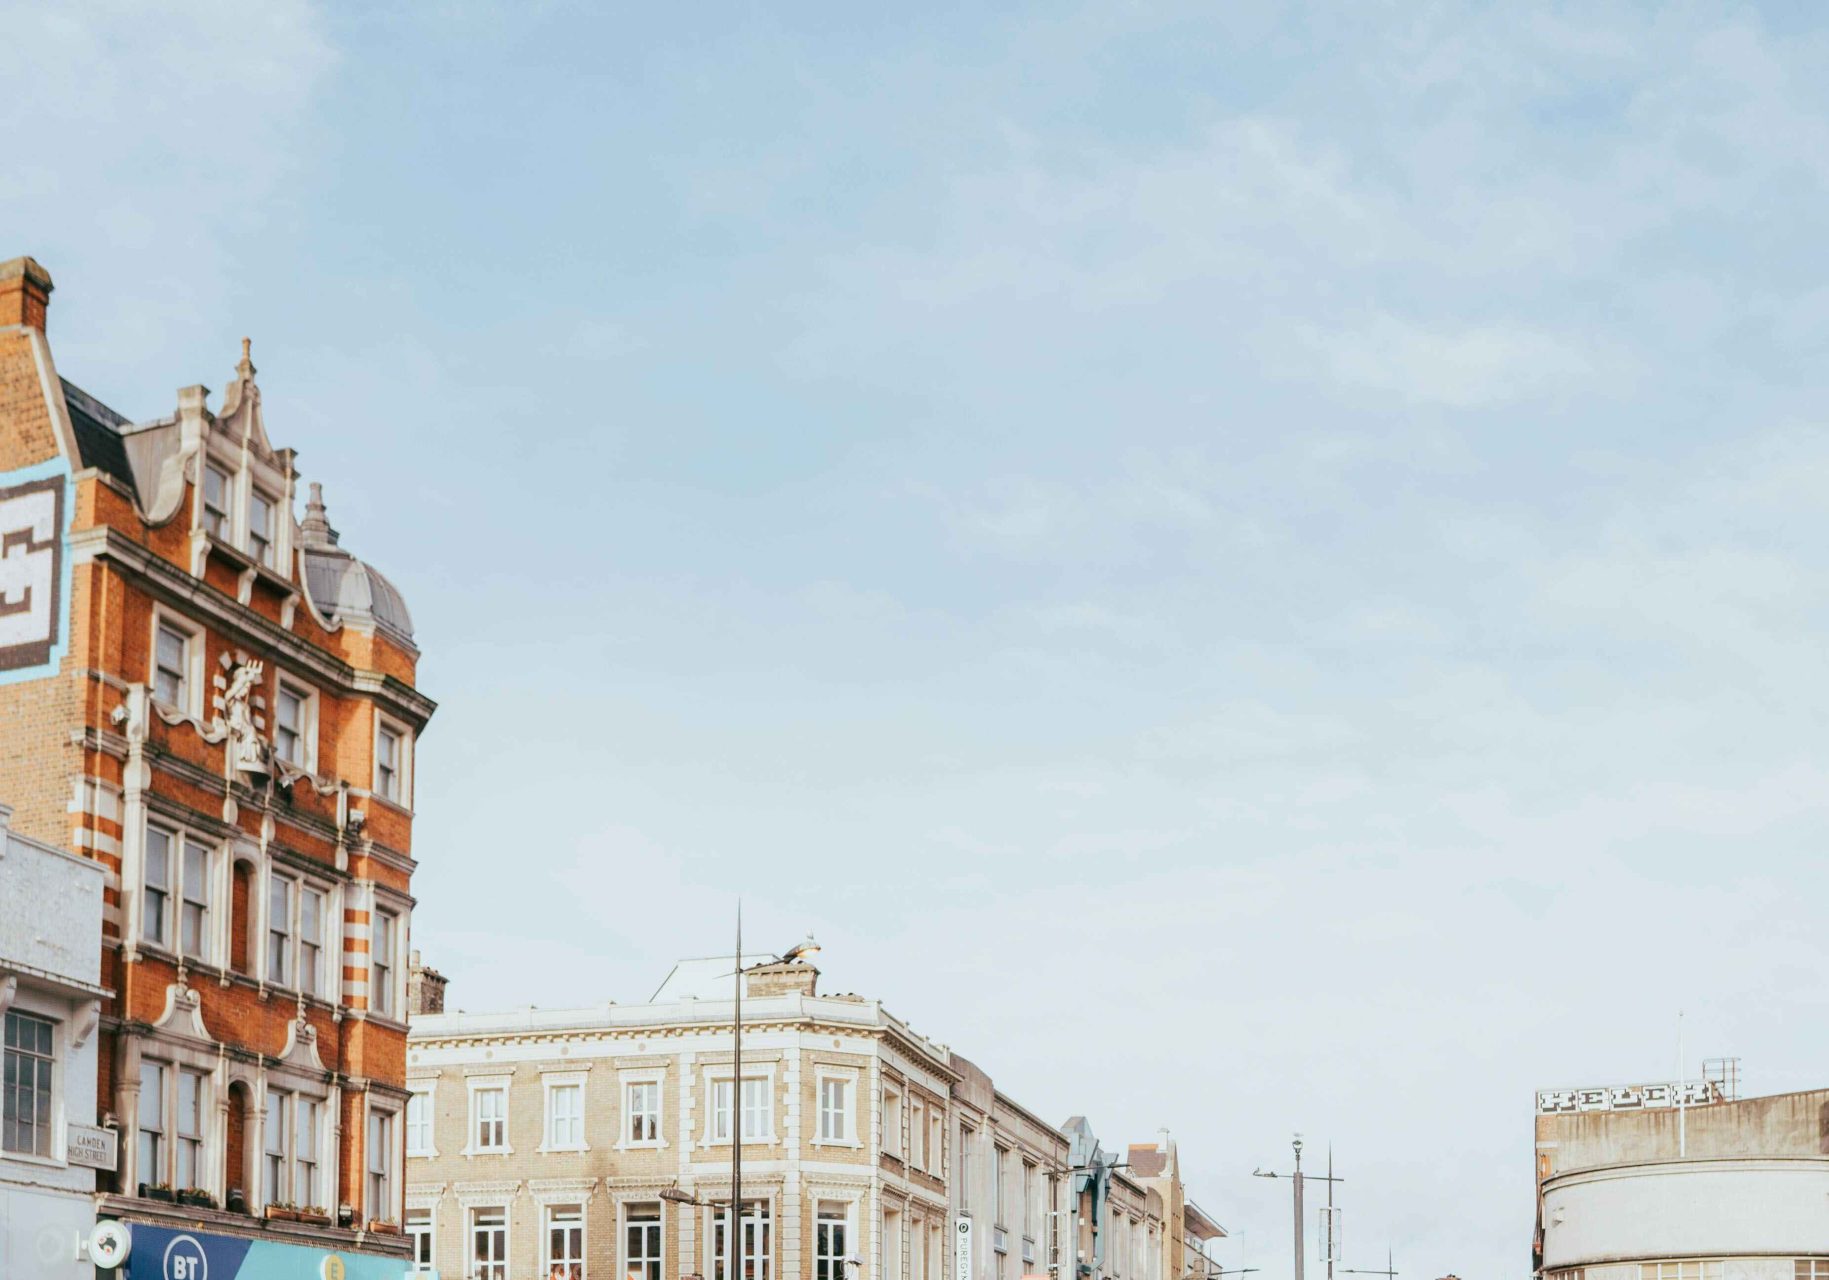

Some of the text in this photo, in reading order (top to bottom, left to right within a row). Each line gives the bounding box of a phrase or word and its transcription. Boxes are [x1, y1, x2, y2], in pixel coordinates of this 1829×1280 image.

[77, 1135, 106, 1151] CAMDEN
[68, 1144, 107, 1162] HIGH STREET
